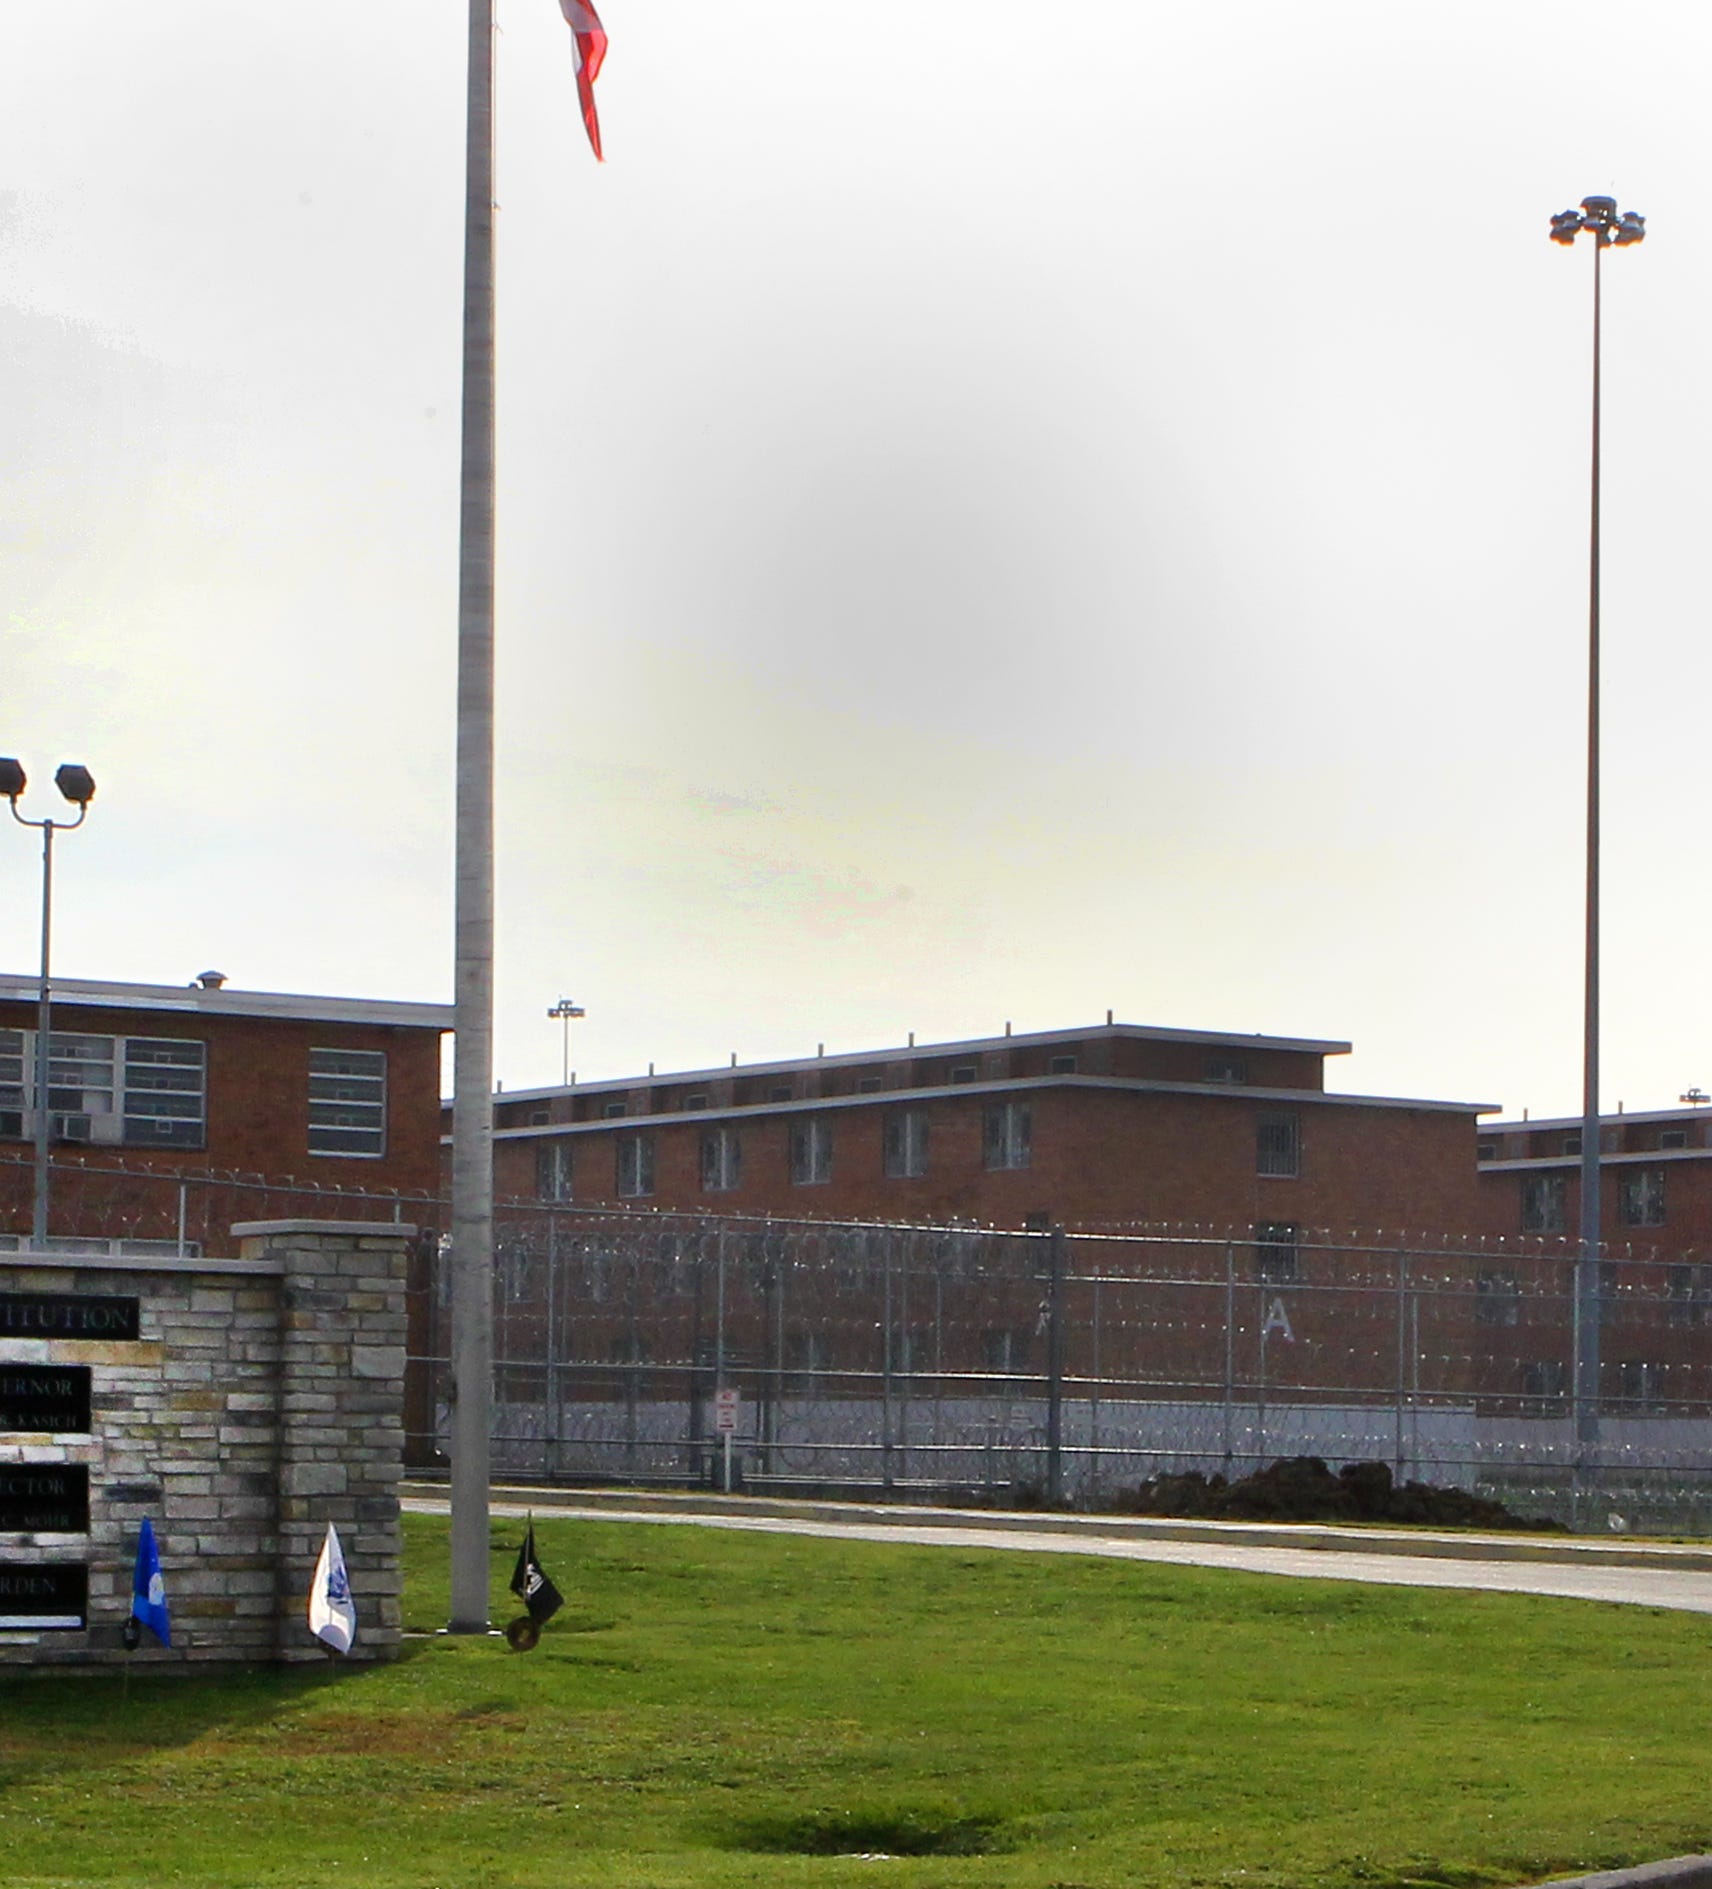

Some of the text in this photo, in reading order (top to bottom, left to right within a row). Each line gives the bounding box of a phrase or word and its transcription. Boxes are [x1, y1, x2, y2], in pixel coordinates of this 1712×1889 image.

[1260, 1297, 1296, 1343] A
[17, 1413, 78, 1428] KASICH
[23, 1513, 71, 1527] MOHR
